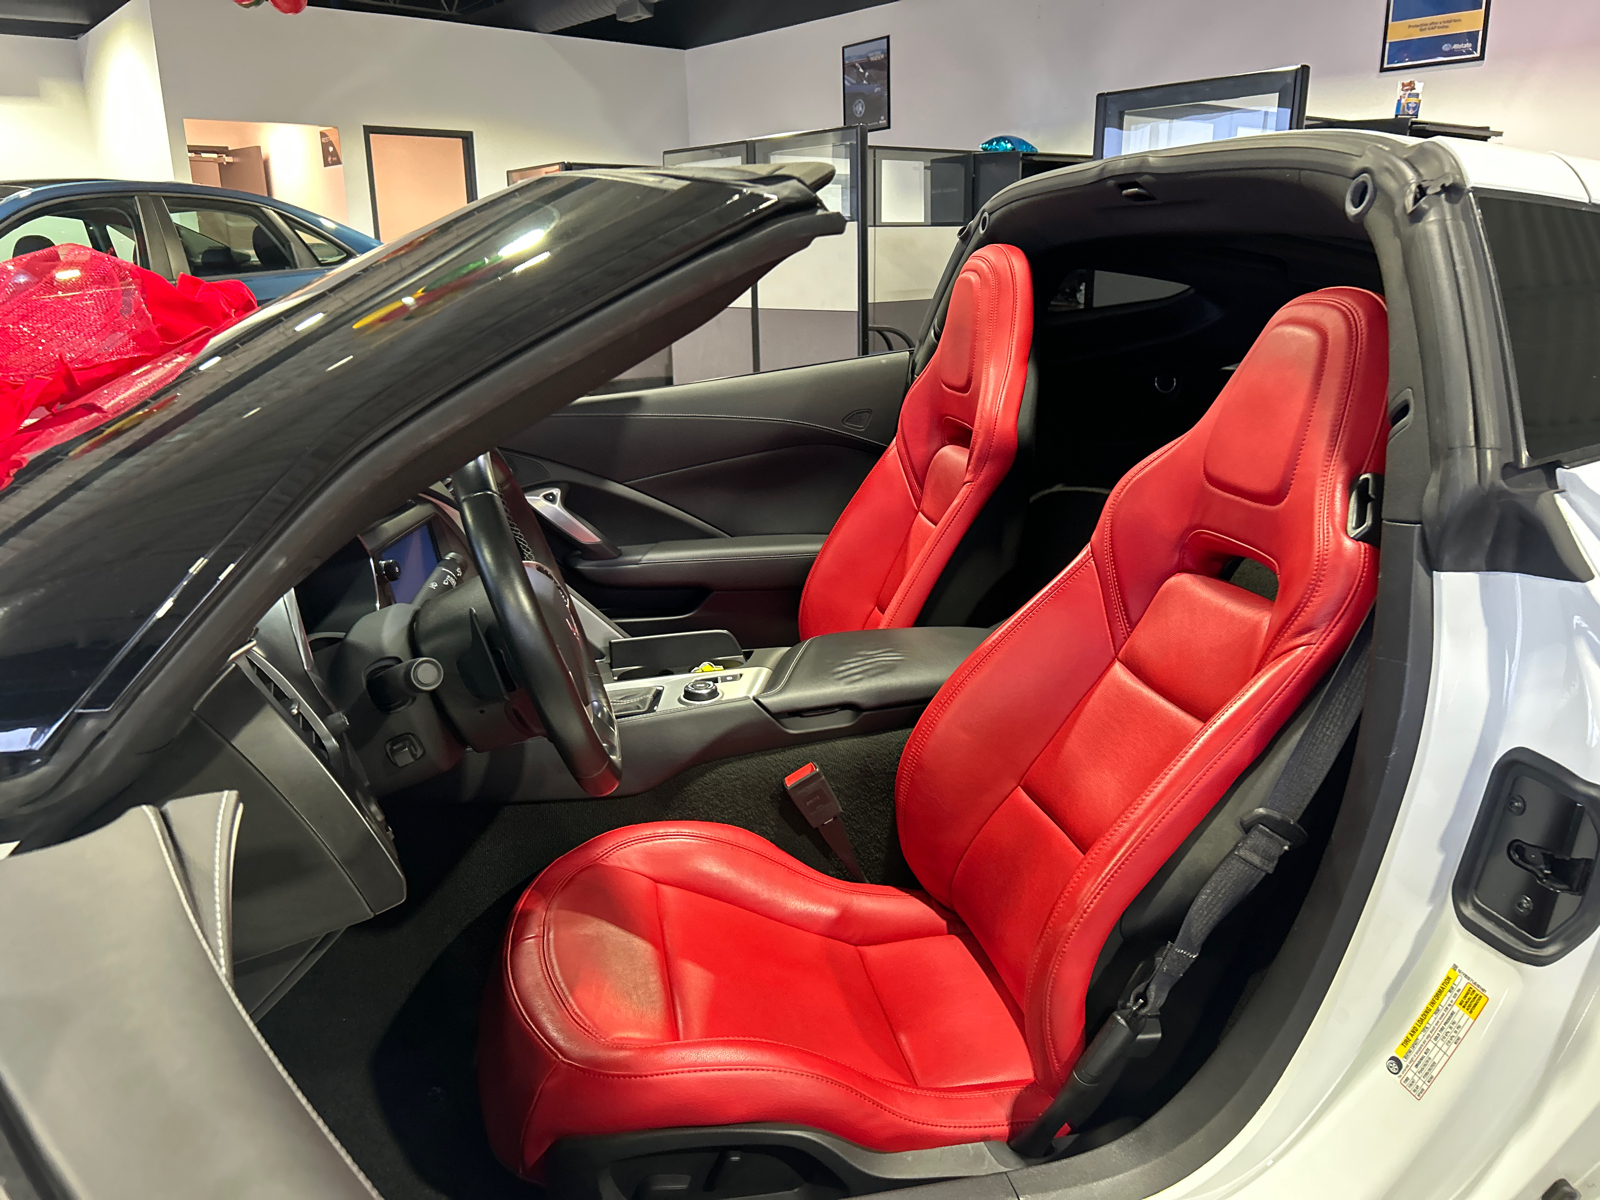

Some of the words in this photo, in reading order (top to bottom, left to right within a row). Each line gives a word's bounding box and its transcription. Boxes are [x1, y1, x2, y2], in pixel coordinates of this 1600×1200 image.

[1401, 1036, 1412, 1048] TIRE
[1408, 1025, 1419, 1038] AND
[1415, 1006, 1432, 1028] LOADING
[1428, 975, 1452, 1008] INFORMATION
